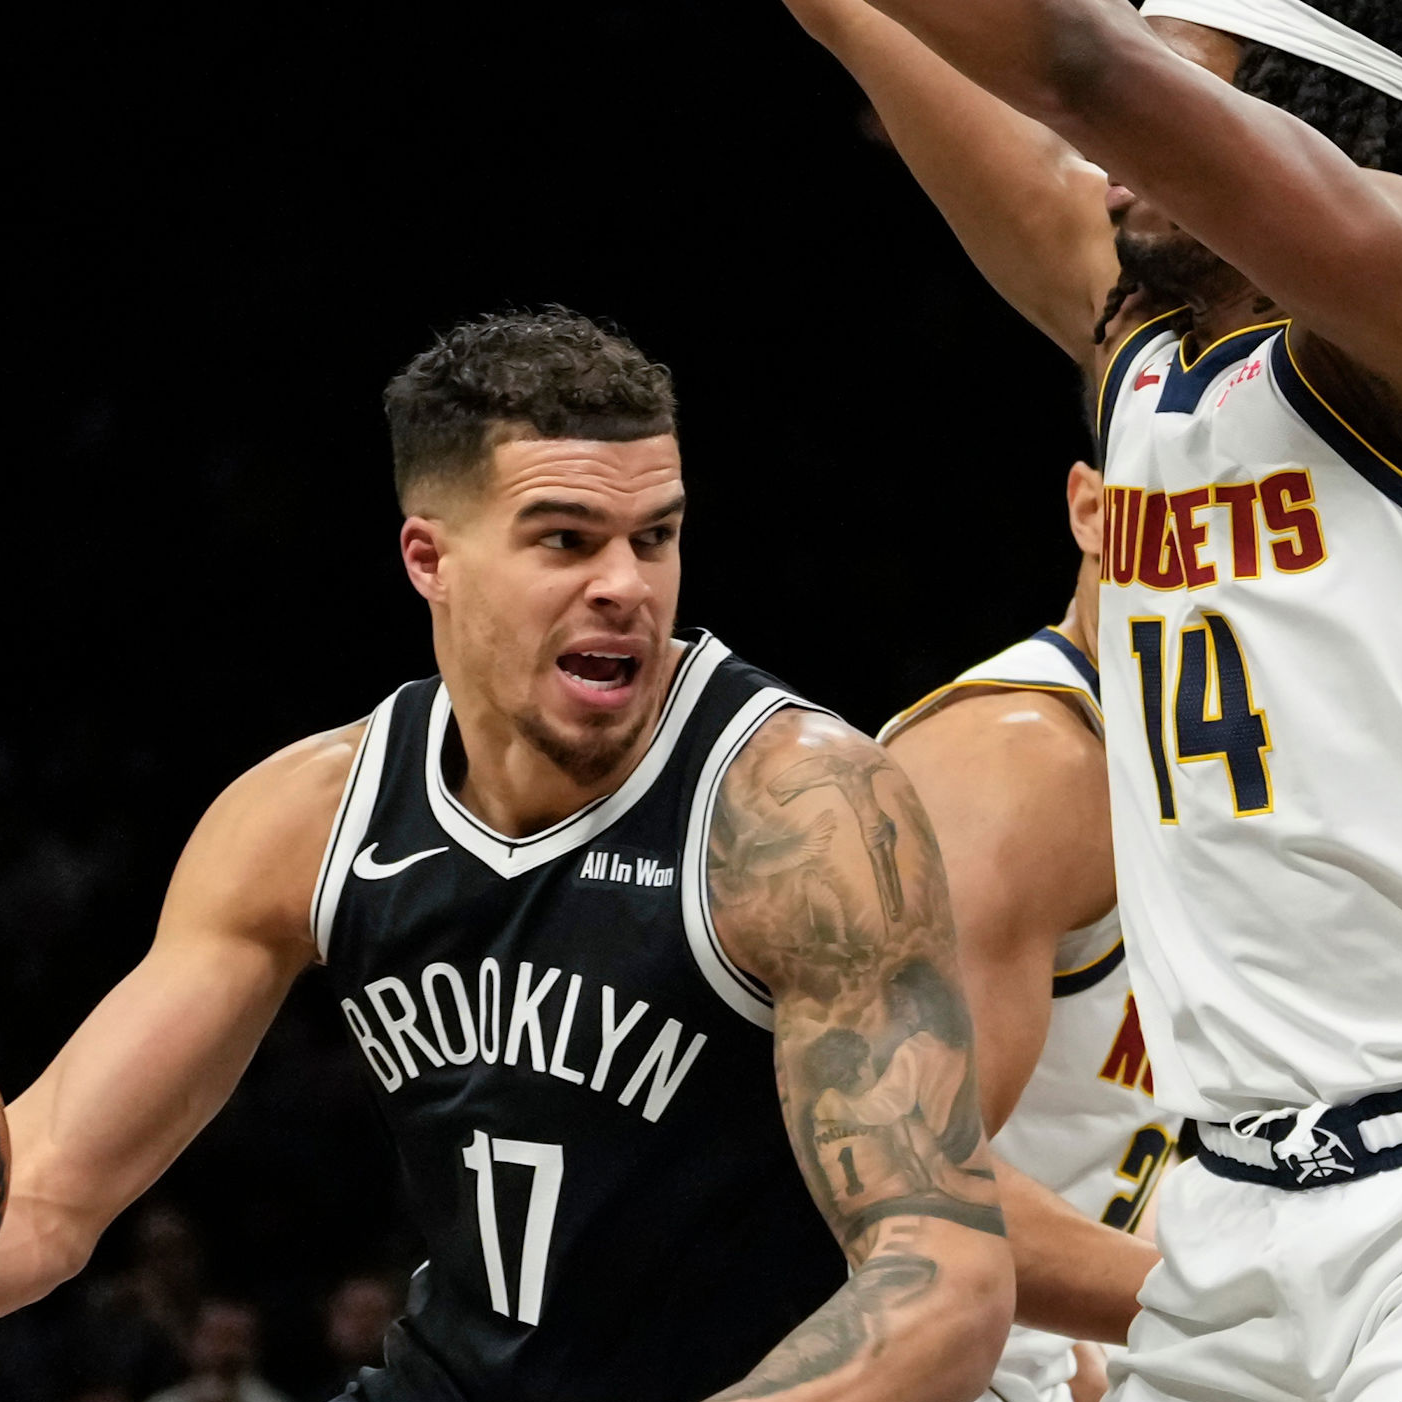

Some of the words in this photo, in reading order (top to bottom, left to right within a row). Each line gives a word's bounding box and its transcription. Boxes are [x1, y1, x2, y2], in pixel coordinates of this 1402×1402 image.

[1099, 467, 1328, 592] NUGETS
[1128, 610, 1274, 826] 14
[579, 851, 609, 880] All
[609, 853, 633, 883] In
[636, 857, 674, 888] Won
[340, 957, 708, 1123] BROOKLYN
[462, 1129, 565, 1326] 17
[1100, 1122, 1177, 1235] 2
